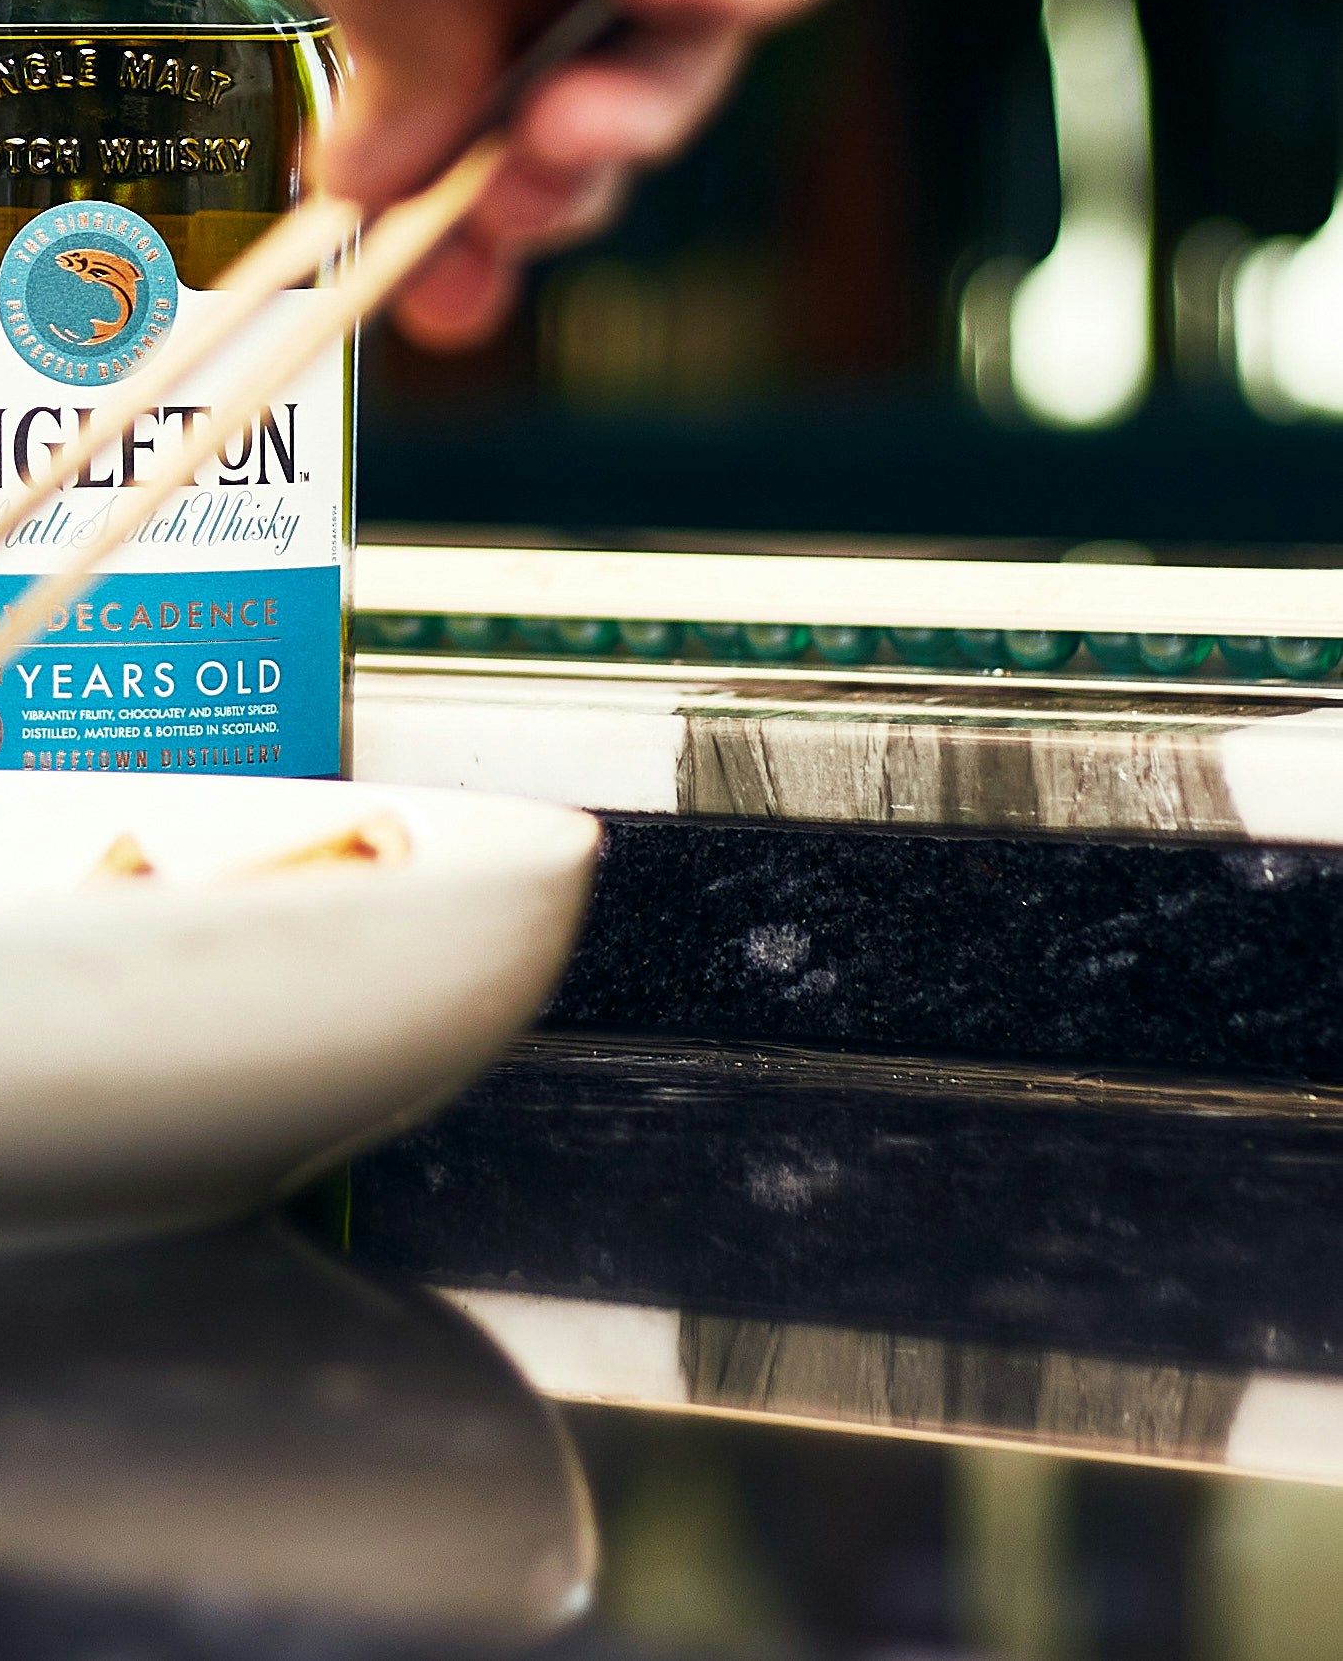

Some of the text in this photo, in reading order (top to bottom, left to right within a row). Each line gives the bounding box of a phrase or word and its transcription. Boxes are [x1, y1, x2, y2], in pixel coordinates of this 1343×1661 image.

[118, 49, 233, 109] MALT
[98, 137, 252, 175] WHISKY
[15, 228, 51, 264] THE
[54, 211, 162, 263] SINGLETON
[5, 299, 89, 381] PERFECTLY
[61, 494, 192, 550] Stch
[189, 490, 300, 556] Whisky
[46, 599, 278, 632] DECADENCE
[16, 659, 281, 699] YEARS OLD
[21, 704, 279, 722] VIBRANTLY FRUITY, CHOCOLATEY AND SUBTLY SPICED.
[21, 722, 279, 741] DISTILLED, MATURED & BOTTLED IN SCOTLAND.
[22, 744, 282, 771] DUFFTOWN DISTILLERY
